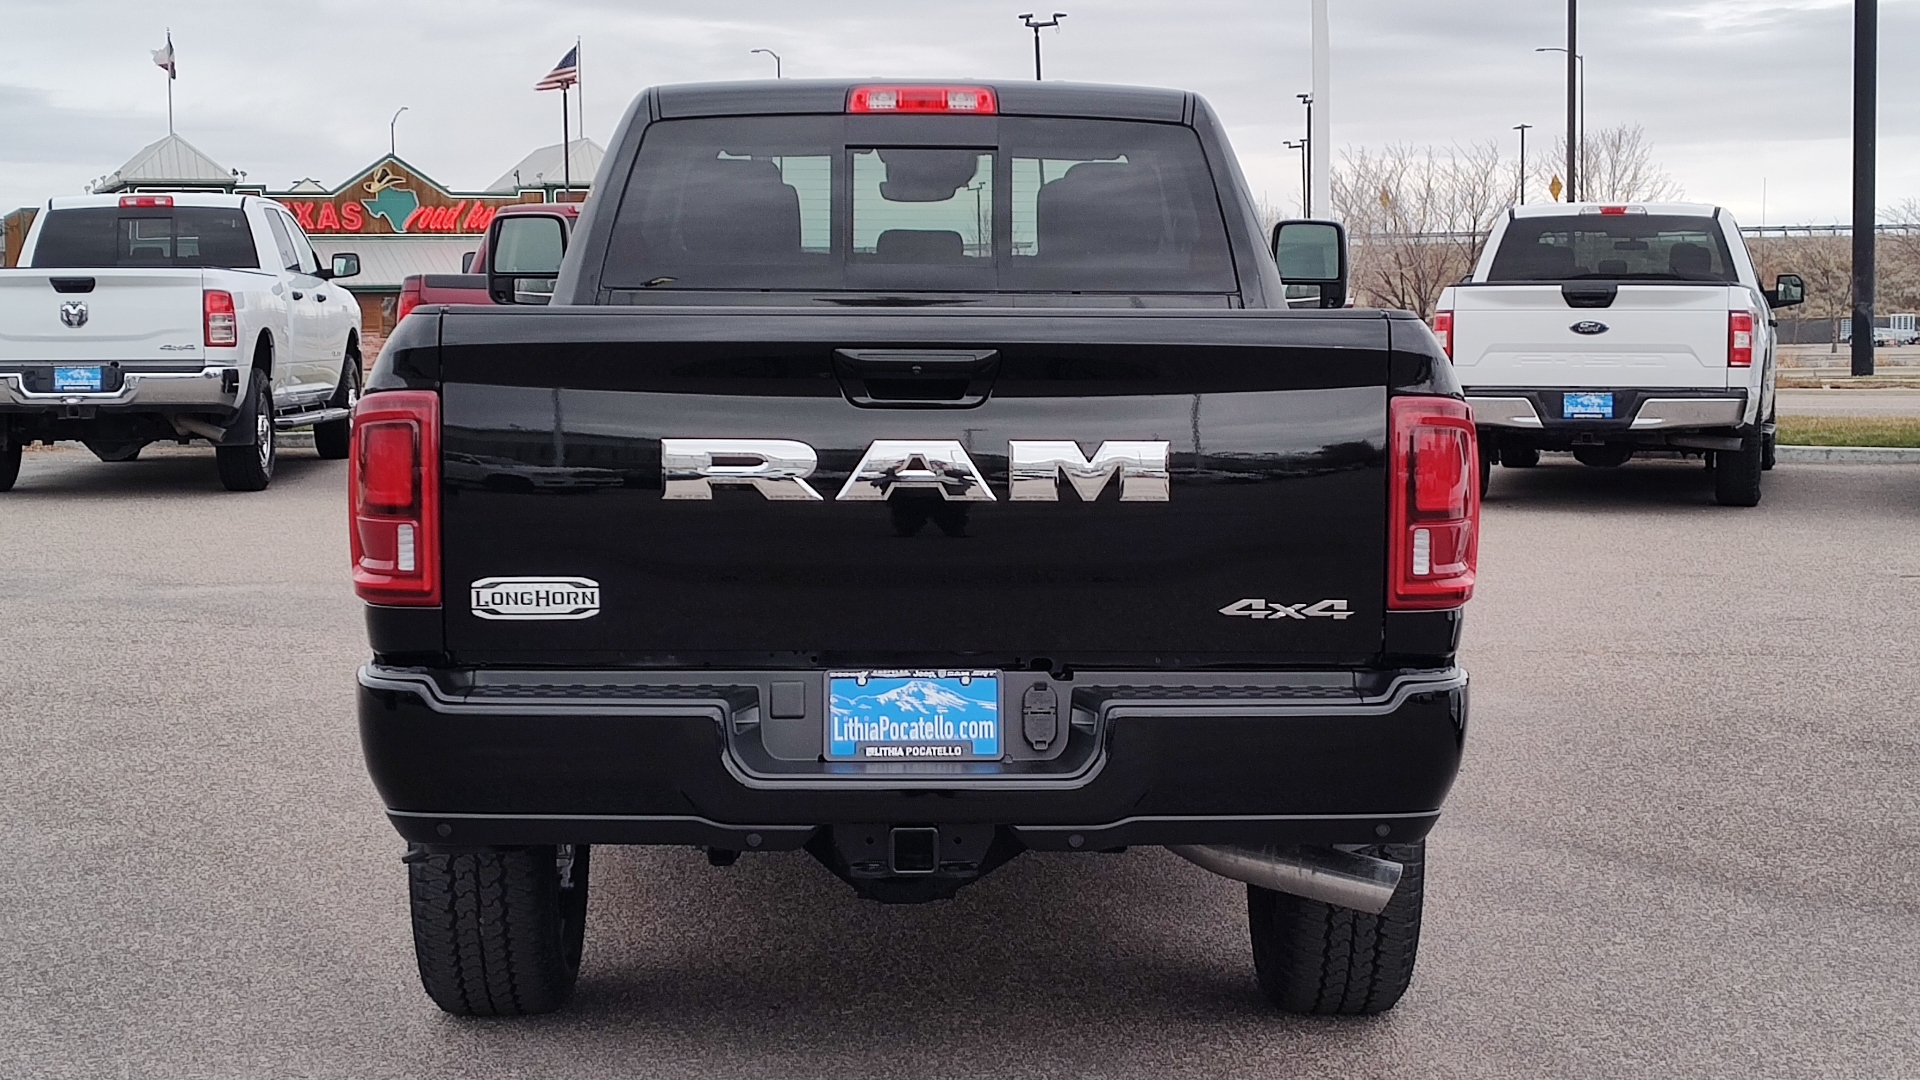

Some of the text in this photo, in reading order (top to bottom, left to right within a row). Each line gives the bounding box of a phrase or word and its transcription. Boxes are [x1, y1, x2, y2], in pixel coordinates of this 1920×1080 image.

[660, 438, 1171, 502] RAM
[1218, 598, 1355, 620] 4x4
[833, 715, 995, 741] LithiaPocatello.com
[905, 746, 962, 756] POCATELLO
